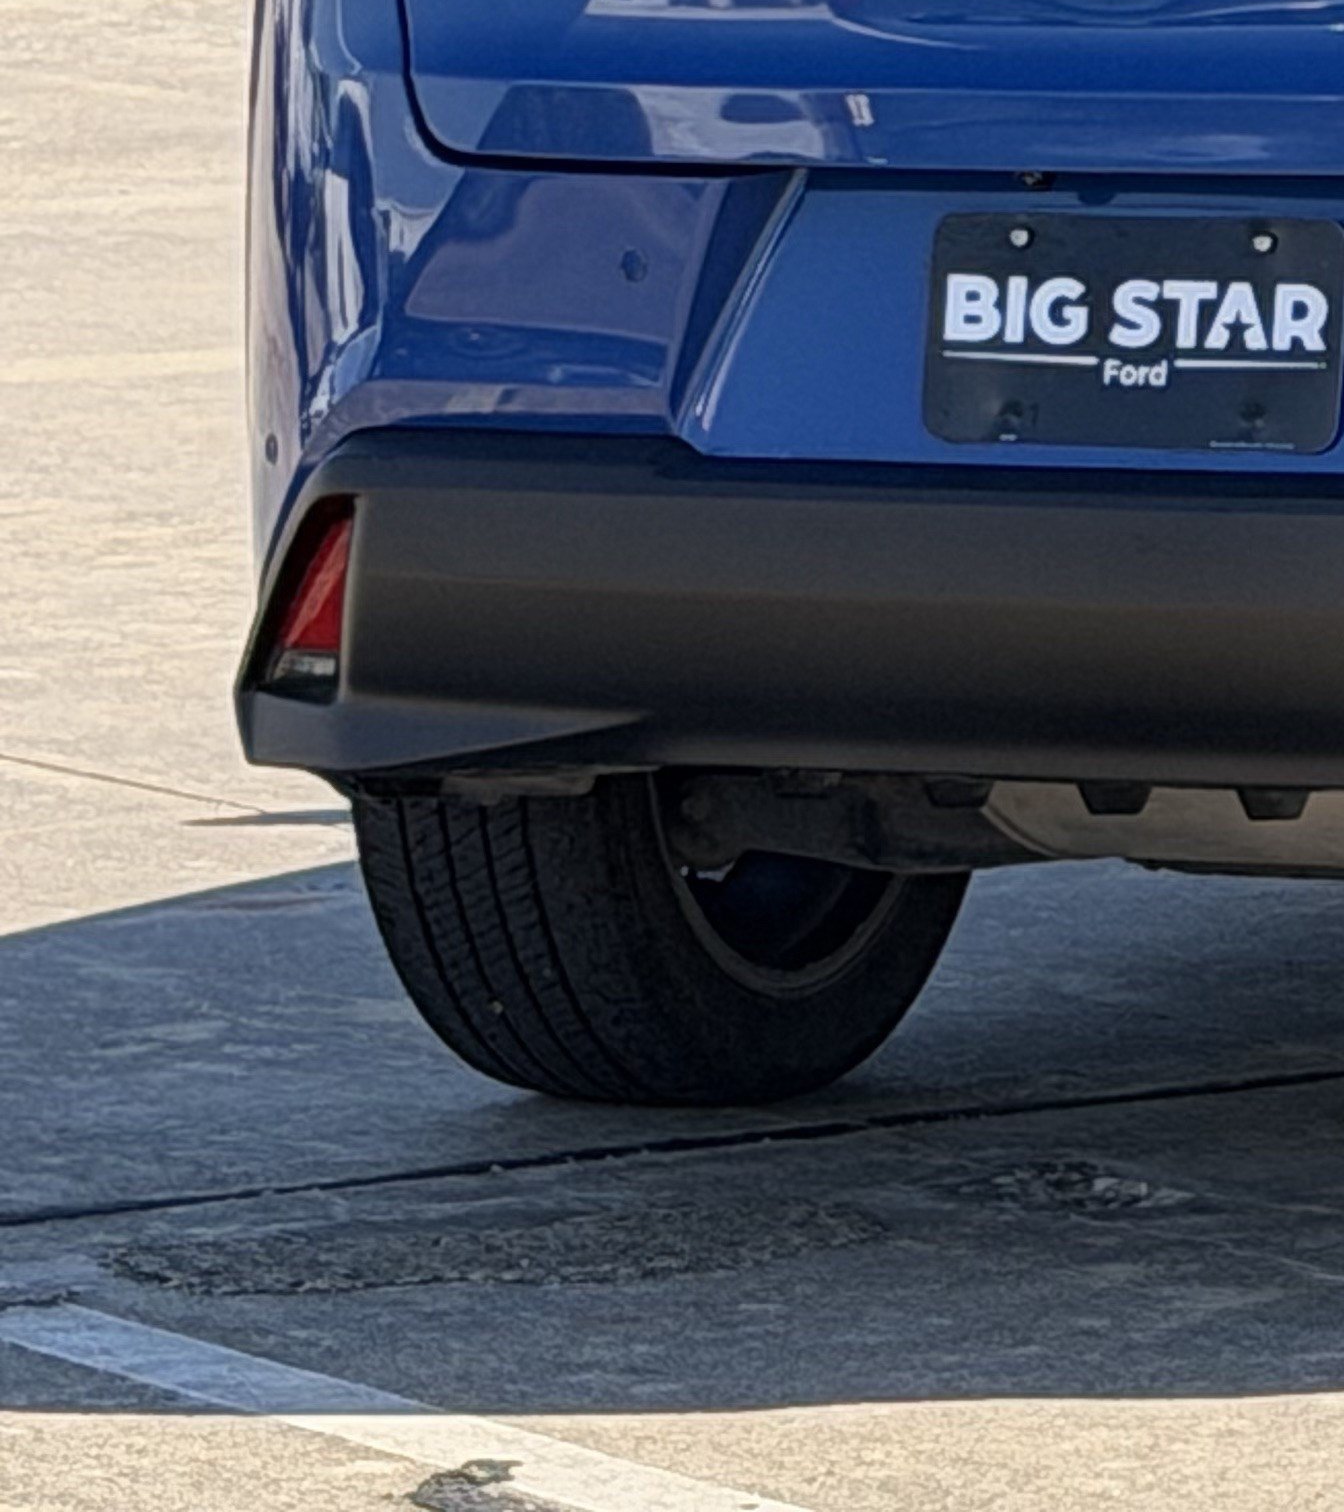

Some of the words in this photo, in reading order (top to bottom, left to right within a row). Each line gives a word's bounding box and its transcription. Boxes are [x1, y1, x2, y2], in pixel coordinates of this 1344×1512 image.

[943, 273, 1089, 345] BIG
[1109, 279, 1329, 351] STAR
[1103, 358, 1169, 387] Ford
